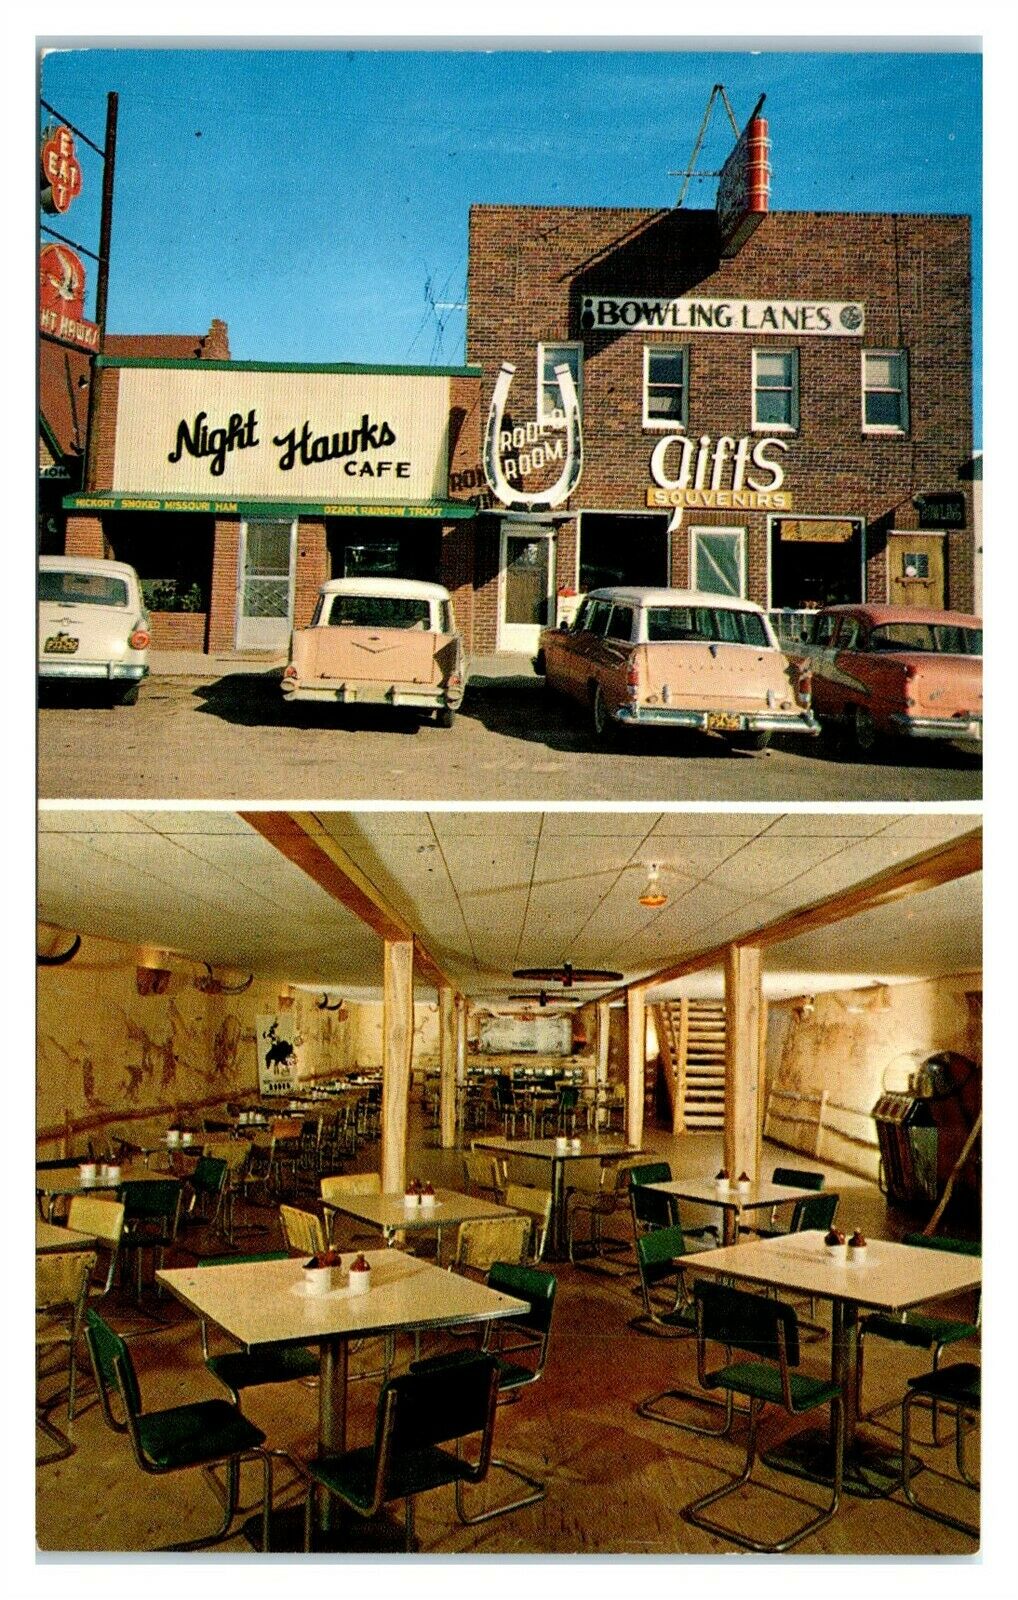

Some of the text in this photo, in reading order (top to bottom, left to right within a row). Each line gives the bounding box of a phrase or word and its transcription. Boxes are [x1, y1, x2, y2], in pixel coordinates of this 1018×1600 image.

[599, 301, 832, 331] BOWLING LANES
[168, 409, 396, 476] Night Hawks
[344, 460, 411, 478] CAFE
[504, 439, 564, 481] ROOM
[75, 498, 238, 512] HICKORY SMOKED MISSOURI HAM
[654, 489, 786, 508] SOUVENIRS
[324, 505, 443, 517] OZARK RAINBOW TROUT
